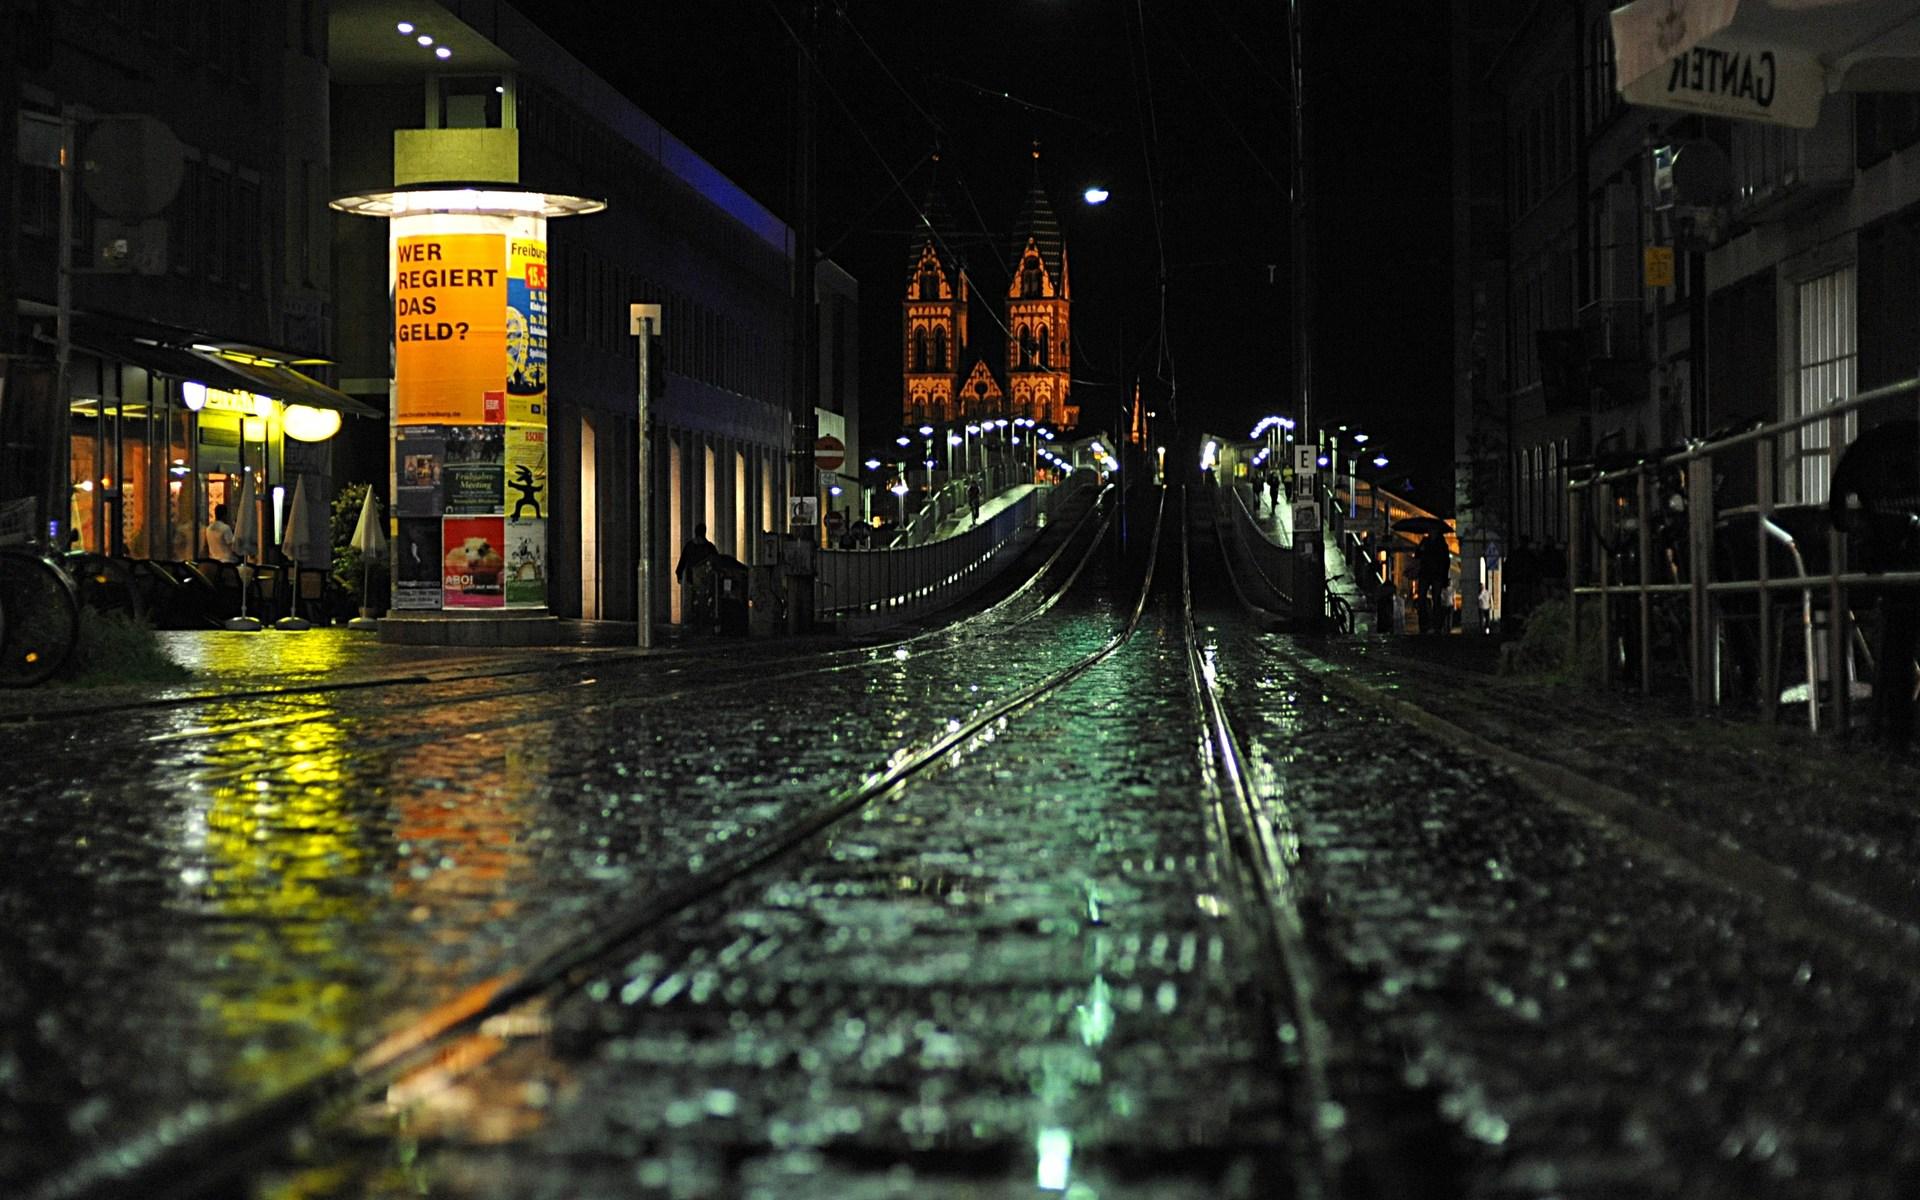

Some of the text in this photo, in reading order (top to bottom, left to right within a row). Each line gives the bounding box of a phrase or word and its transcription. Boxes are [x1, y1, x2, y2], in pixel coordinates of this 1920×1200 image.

[399, 243, 442, 262] WER
[399, 269, 498, 289] REGIERT
[399, 296, 437, 315] DAS
[399, 322, 469, 342] GELD?
[1301, 450, 1309, 468] E
[445, 575, 473, 584] ABO!
